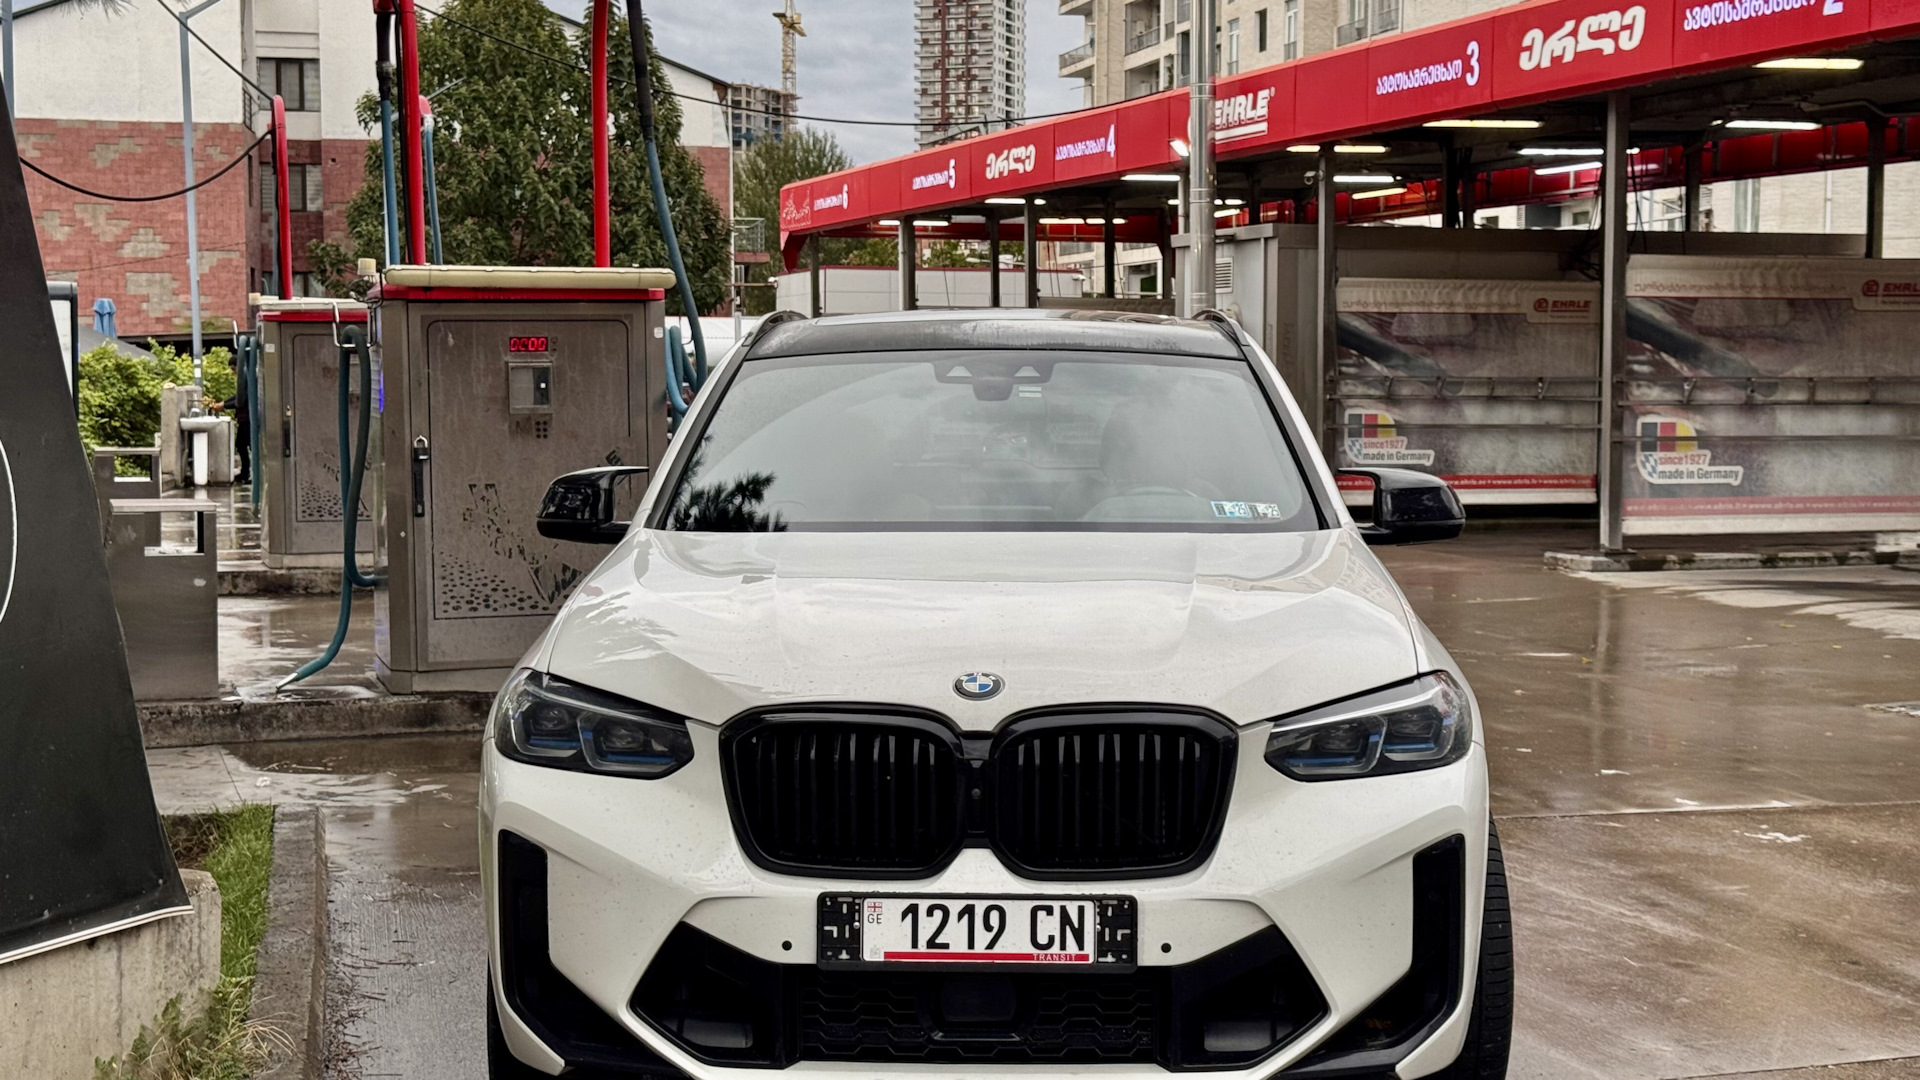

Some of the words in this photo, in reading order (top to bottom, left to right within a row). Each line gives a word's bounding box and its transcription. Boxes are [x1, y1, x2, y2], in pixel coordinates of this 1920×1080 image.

[1519, 5, 1646, 71] ერლე
[1466, 41, 1480, 86] 3
[1106, 124, 1116, 158] 4
[948, 159, 956, 189] 5
[985, 144, 1036, 180] ერლე
[842, 184, 849, 210] 6
[1363, 451, 1386, 461] made
[1387, 451, 1395, 461] in
[1396, 452, 1431, 462] Germany
[1658, 468, 1685, 479] made
[1687, 468, 1695, 479] in
[1697, 468, 1739, 481] Germany
[867, 913, 883, 924] GE
[901, 903, 1006, 950] 1219
[1030, 904, 1085, 951] CN
[1033, 953, 1076, 961] TRANSIT
